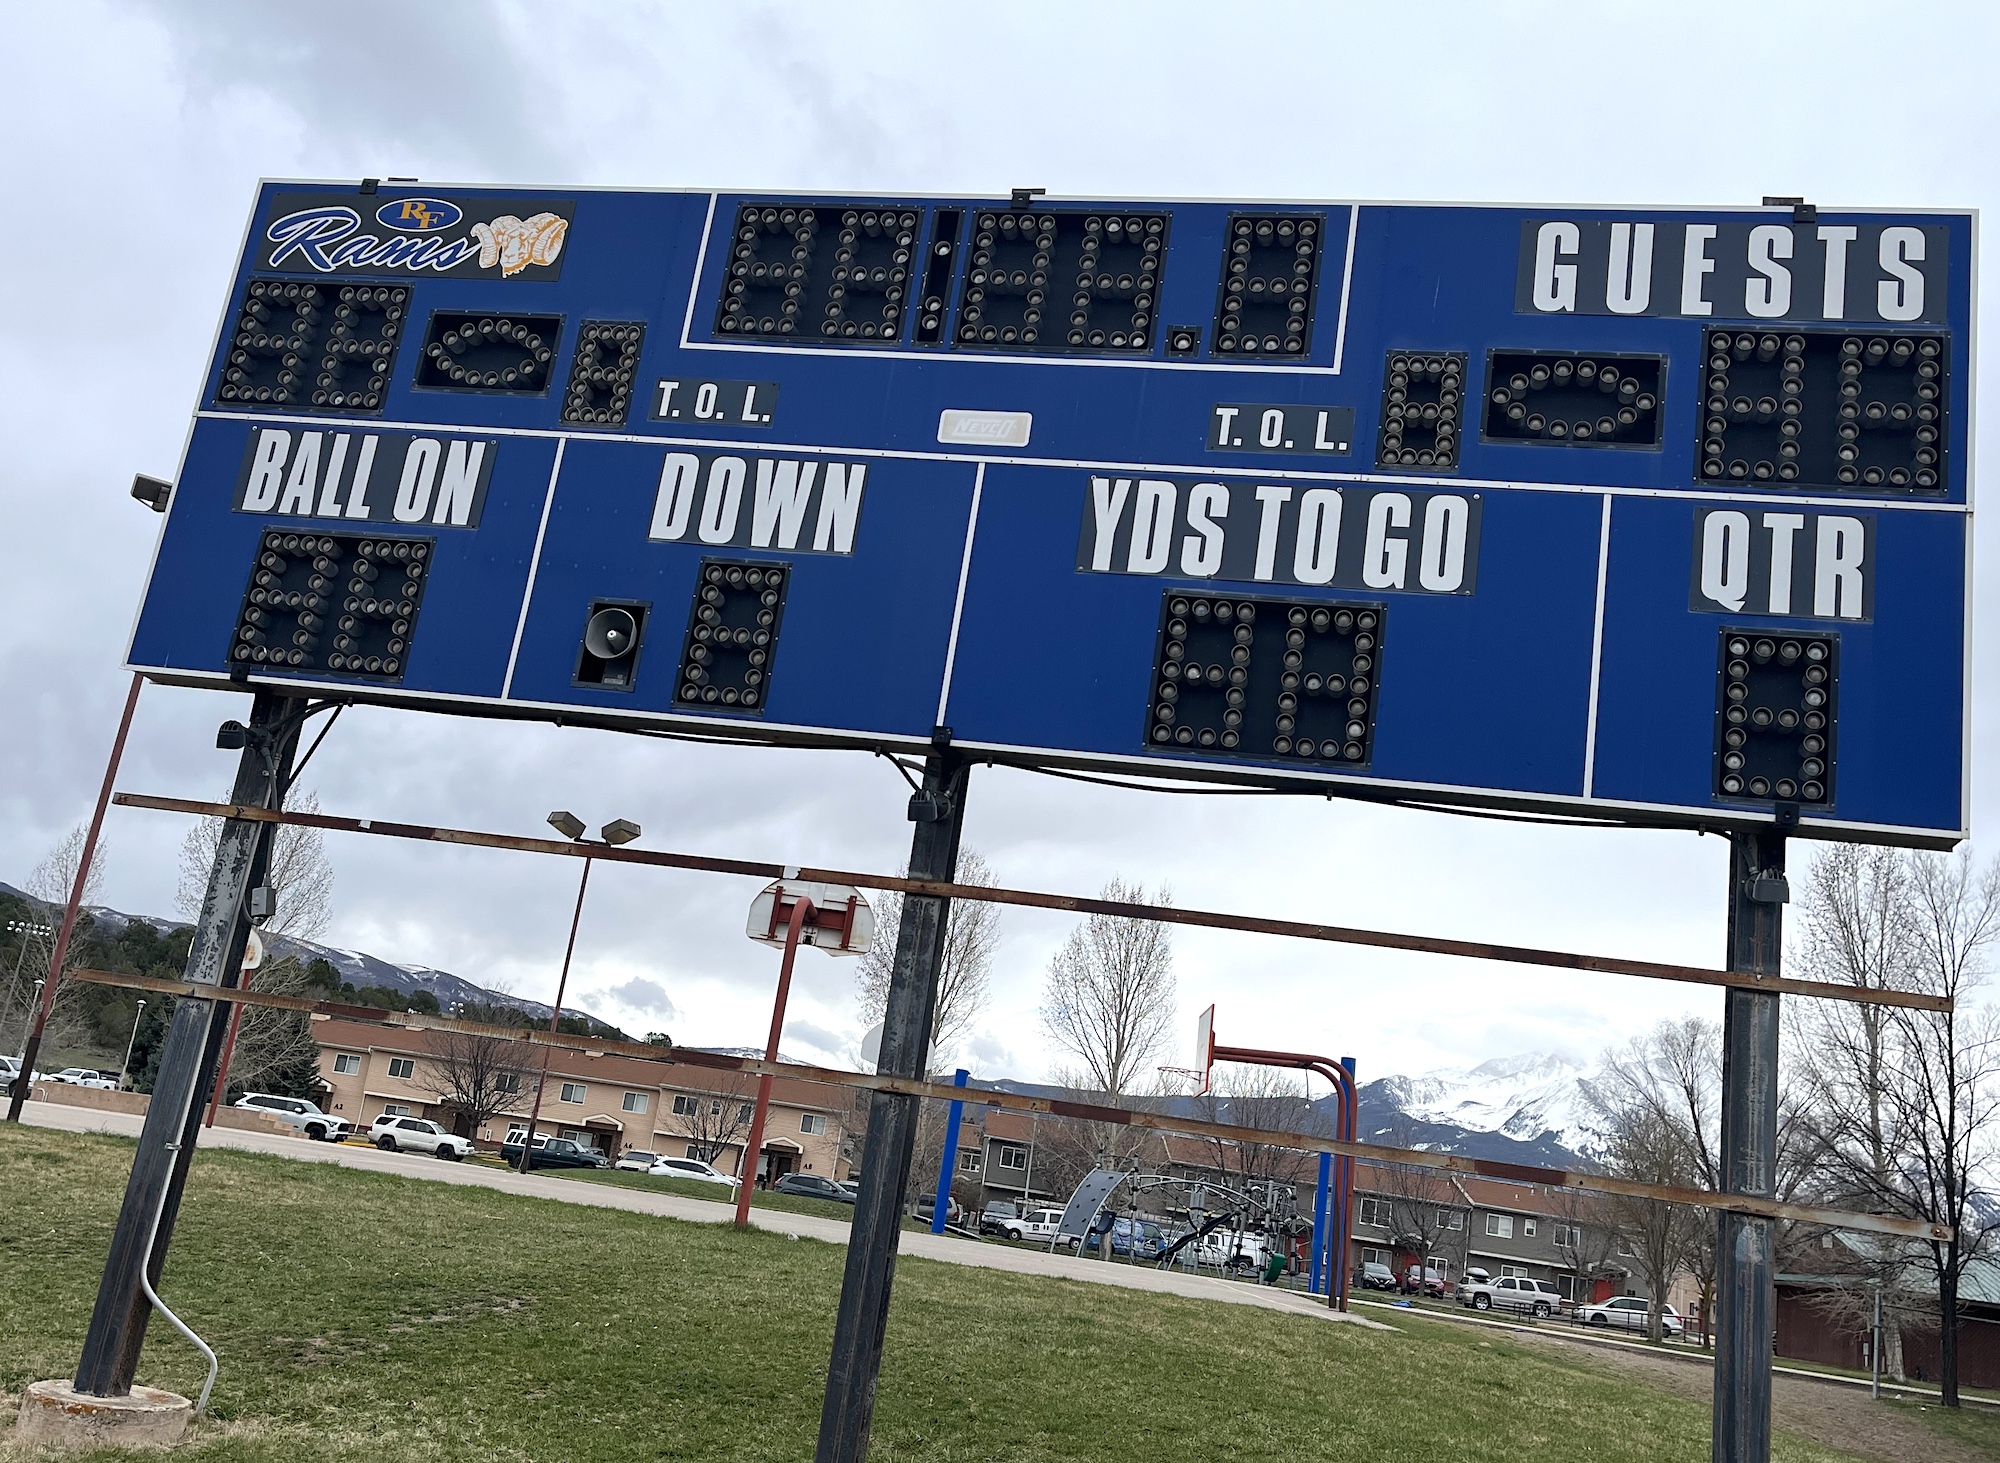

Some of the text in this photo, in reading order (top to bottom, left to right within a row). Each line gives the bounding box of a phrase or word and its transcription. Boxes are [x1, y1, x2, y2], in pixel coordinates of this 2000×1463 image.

[267, 206, 482, 272] Rams
[397, 200, 445, 229] RF
[1532, 221, 1926, 321] GUESTS
[241, 428, 487, 526] BALL ON
[648, 452, 867, 553] DOWN
[1091, 477, 1469, 592] YDS TO GO
[1700, 510, 1865, 619] QTR
